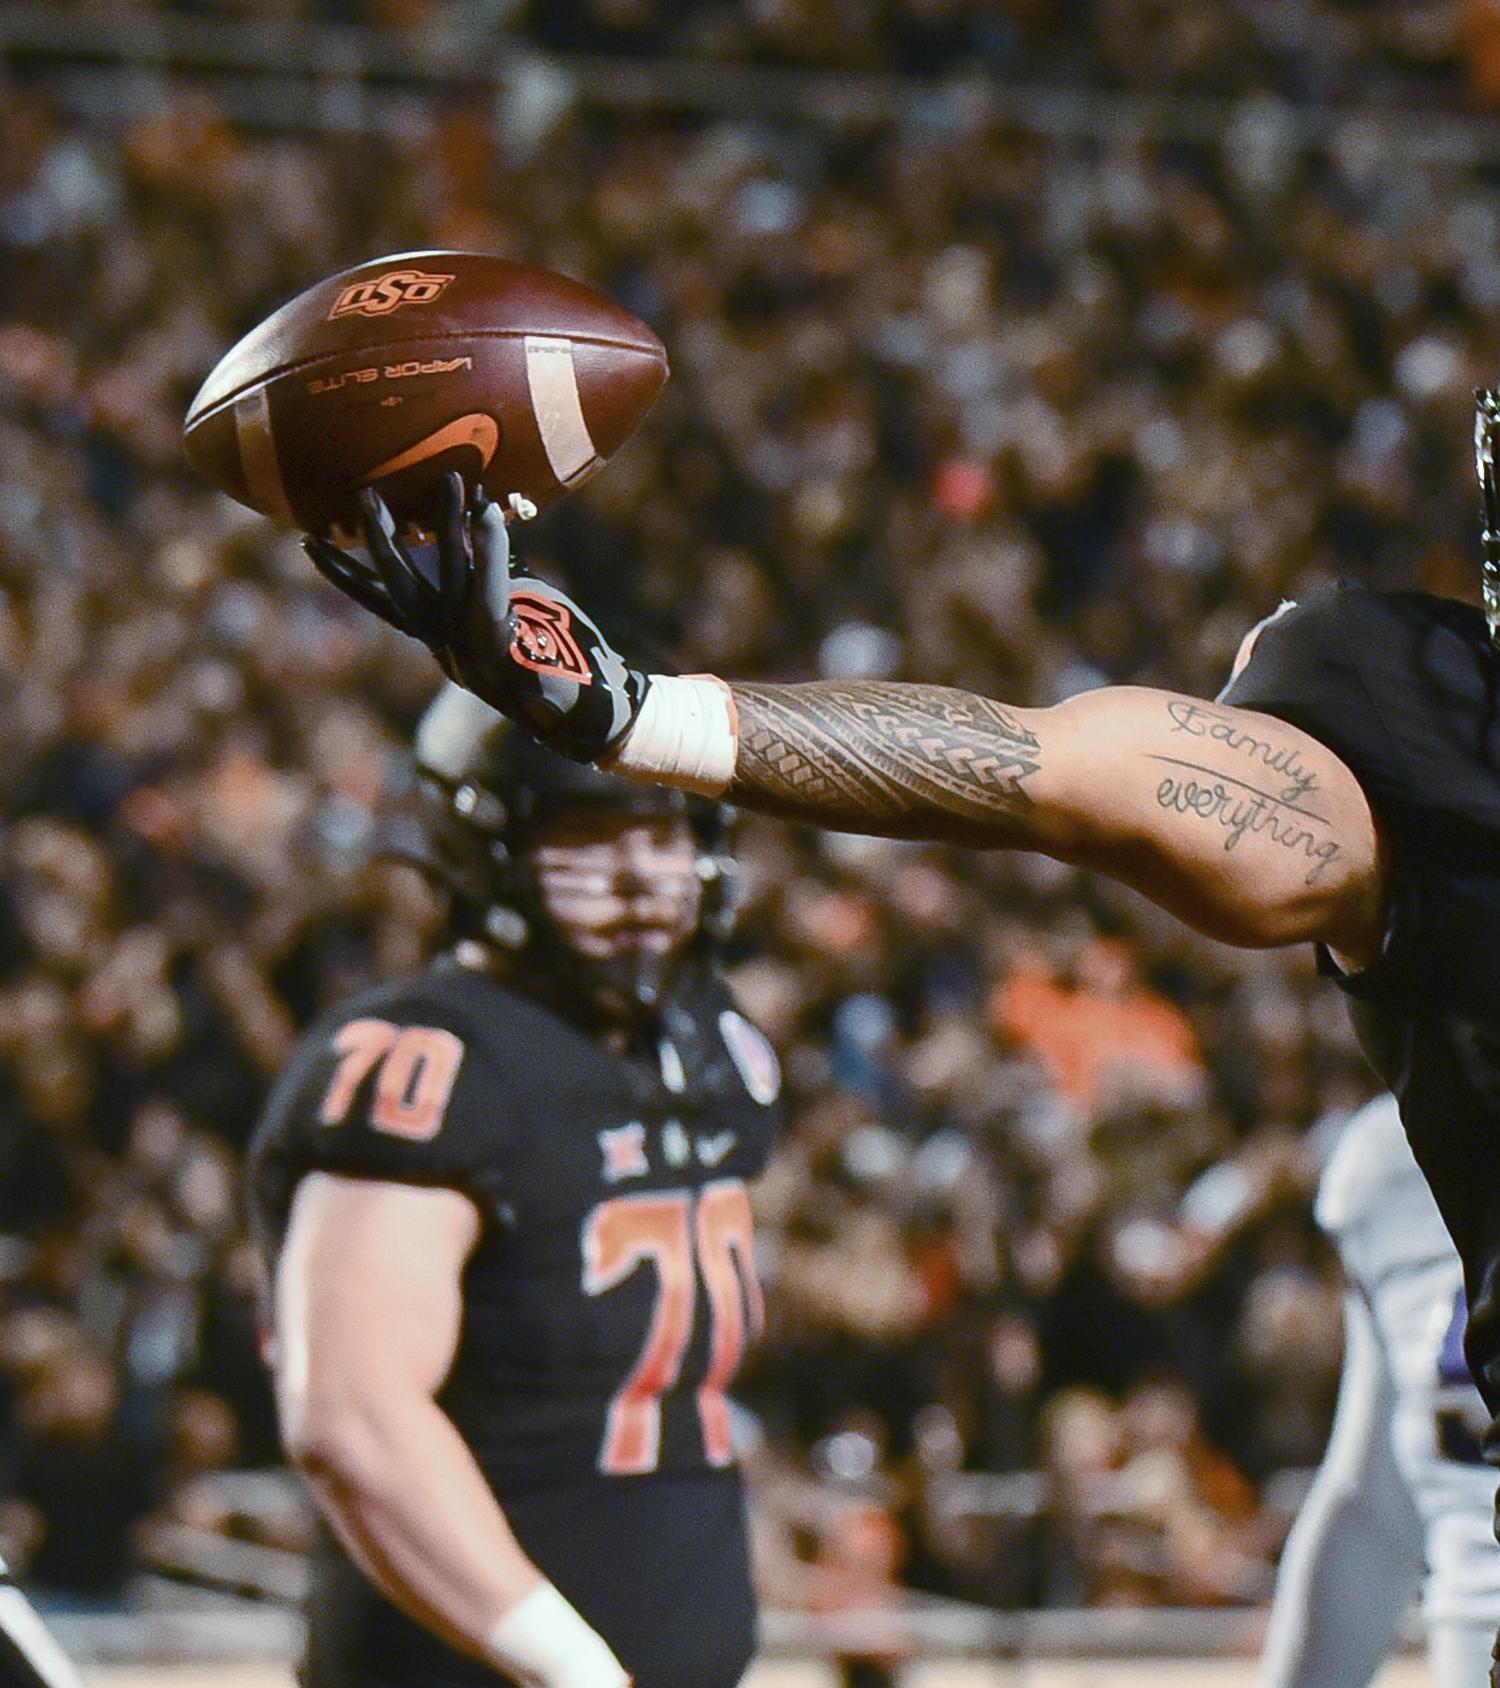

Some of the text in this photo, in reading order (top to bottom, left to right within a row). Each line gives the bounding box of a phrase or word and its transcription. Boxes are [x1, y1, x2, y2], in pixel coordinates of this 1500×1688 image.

[327, 269, 456, 320] OSU
[307, 357, 473, 395] VAPOR ELITE
[1167, 701, 1320, 802] Family
[1157, 777, 1340, 885] everything
[319, 1017, 465, 1142] 70
